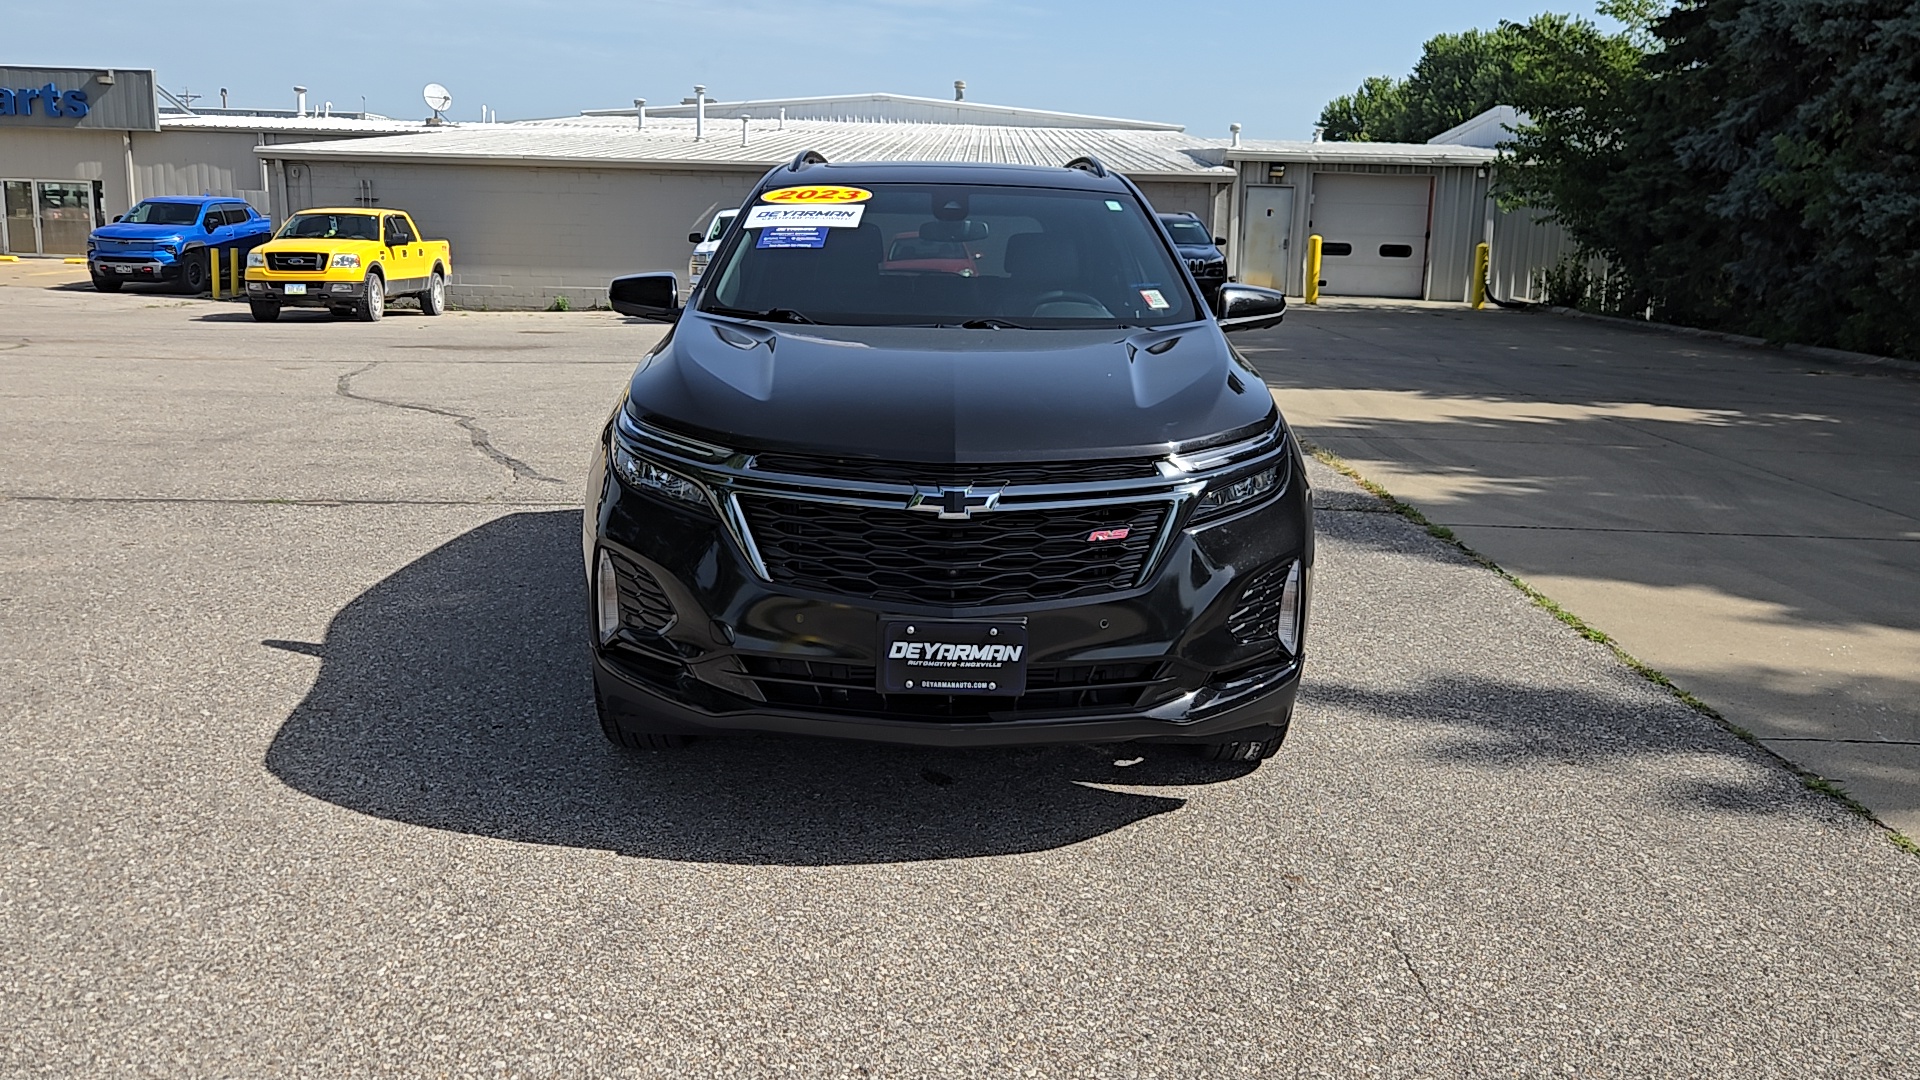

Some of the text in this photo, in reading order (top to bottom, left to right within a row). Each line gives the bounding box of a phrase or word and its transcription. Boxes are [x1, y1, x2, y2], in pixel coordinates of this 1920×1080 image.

[771, 190, 861, 200] 2023
[756, 210, 856, 218] DEYARMAN
[1087, 528, 1130, 541] RS
[888, 641, 1024, 661] DEYARMAN
[921, 680, 988, 689] DEYARMANAUTO.COM
